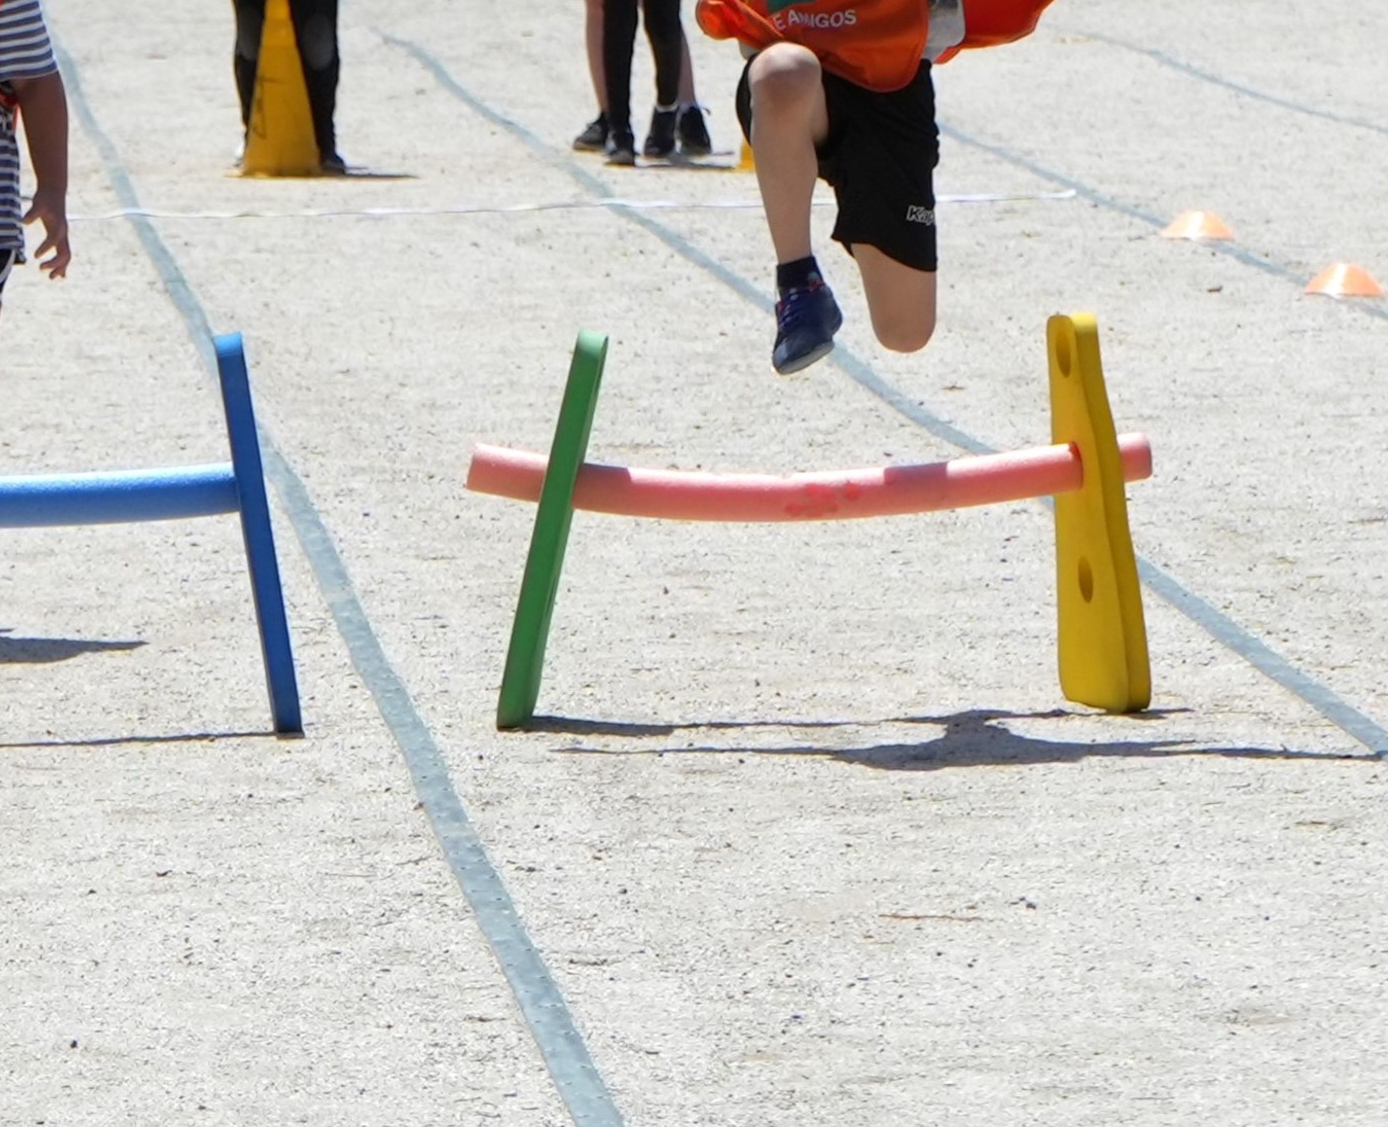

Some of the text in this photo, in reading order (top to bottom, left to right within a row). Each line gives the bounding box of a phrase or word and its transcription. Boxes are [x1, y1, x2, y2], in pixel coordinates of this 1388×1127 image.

[773, 9, 857, 31] E AMIGOS
[906, 205, 935, 226] Kap
